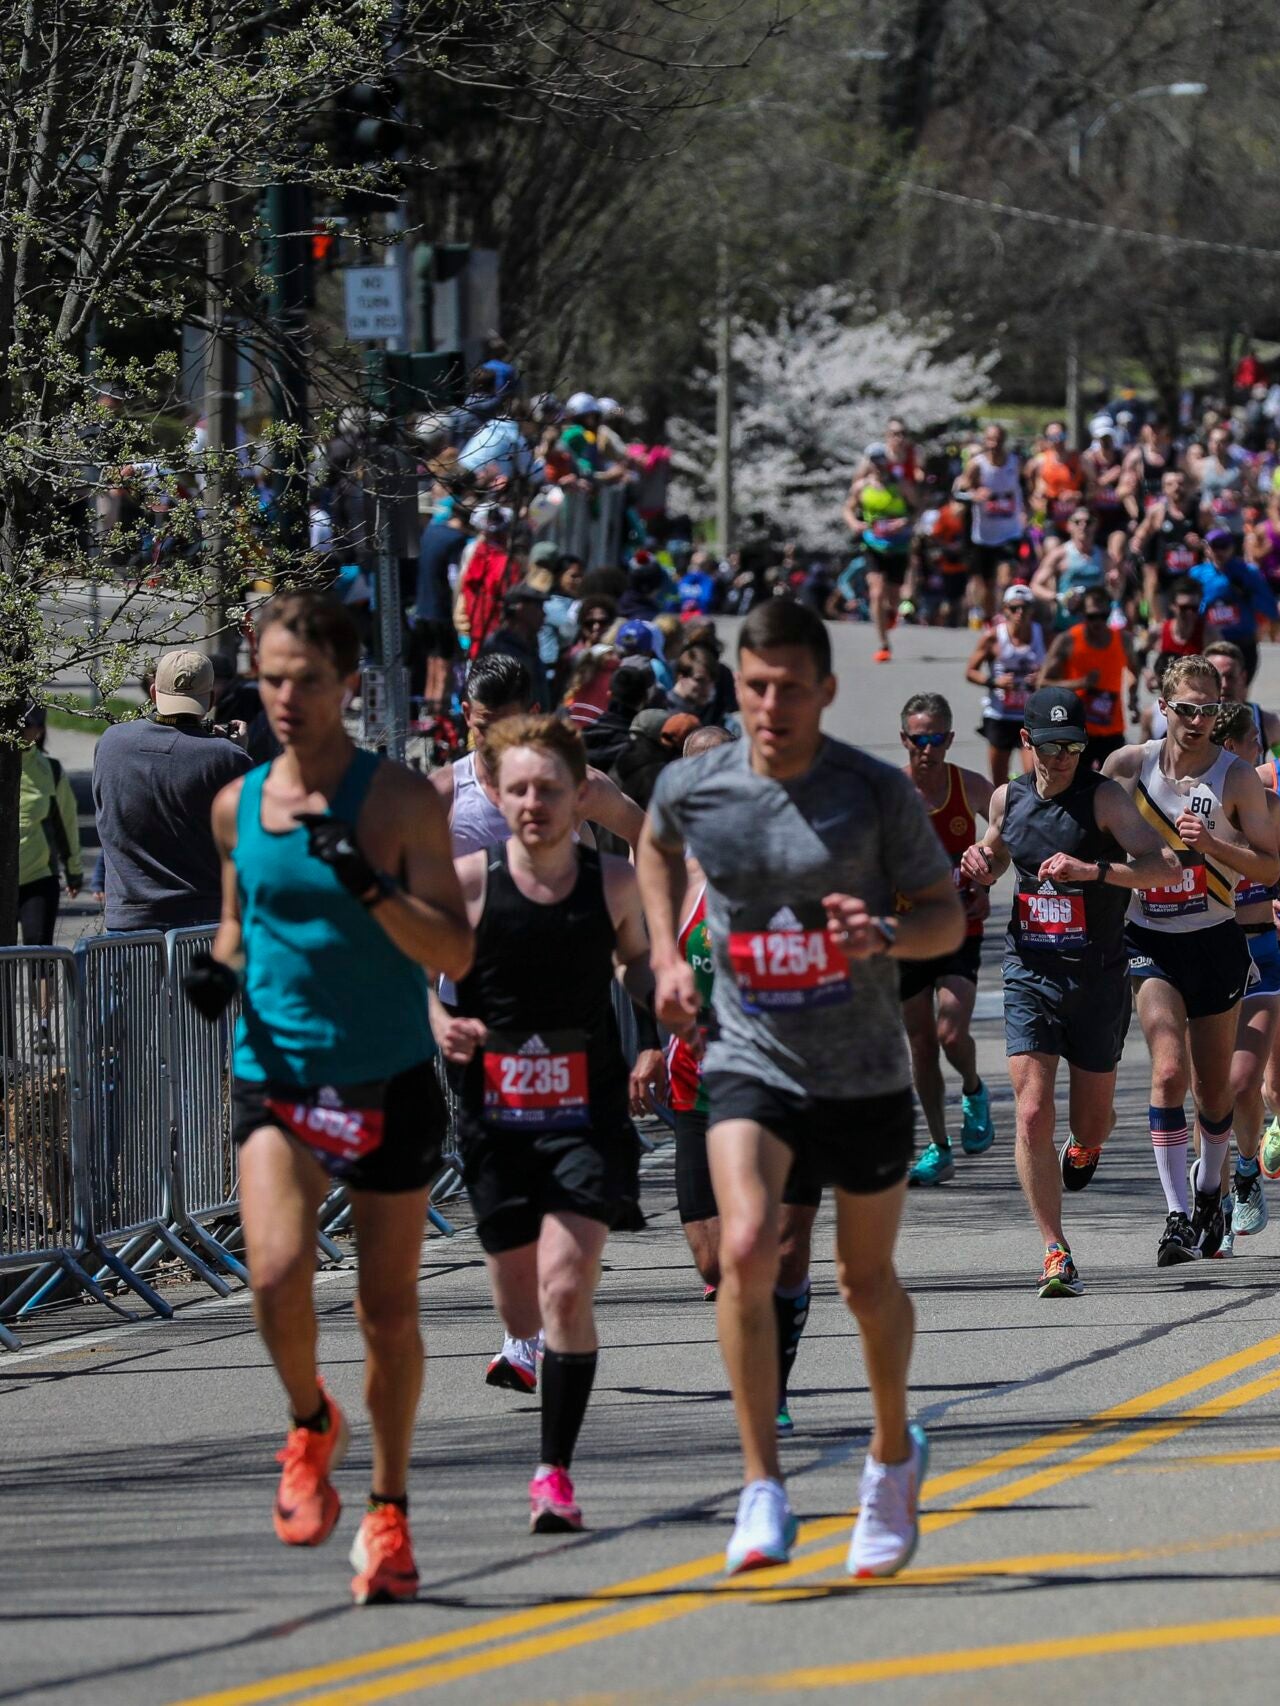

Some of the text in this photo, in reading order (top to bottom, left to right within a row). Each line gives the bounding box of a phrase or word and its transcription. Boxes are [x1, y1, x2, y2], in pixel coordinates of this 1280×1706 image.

[1191, 797, 1212, 818] BQ
[1207, 820, 1216, 830] 19
[1028, 896, 1072, 923] 2969
[750, 932, 828, 976] 1254
[501, 1057, 570, 1094] 2235
